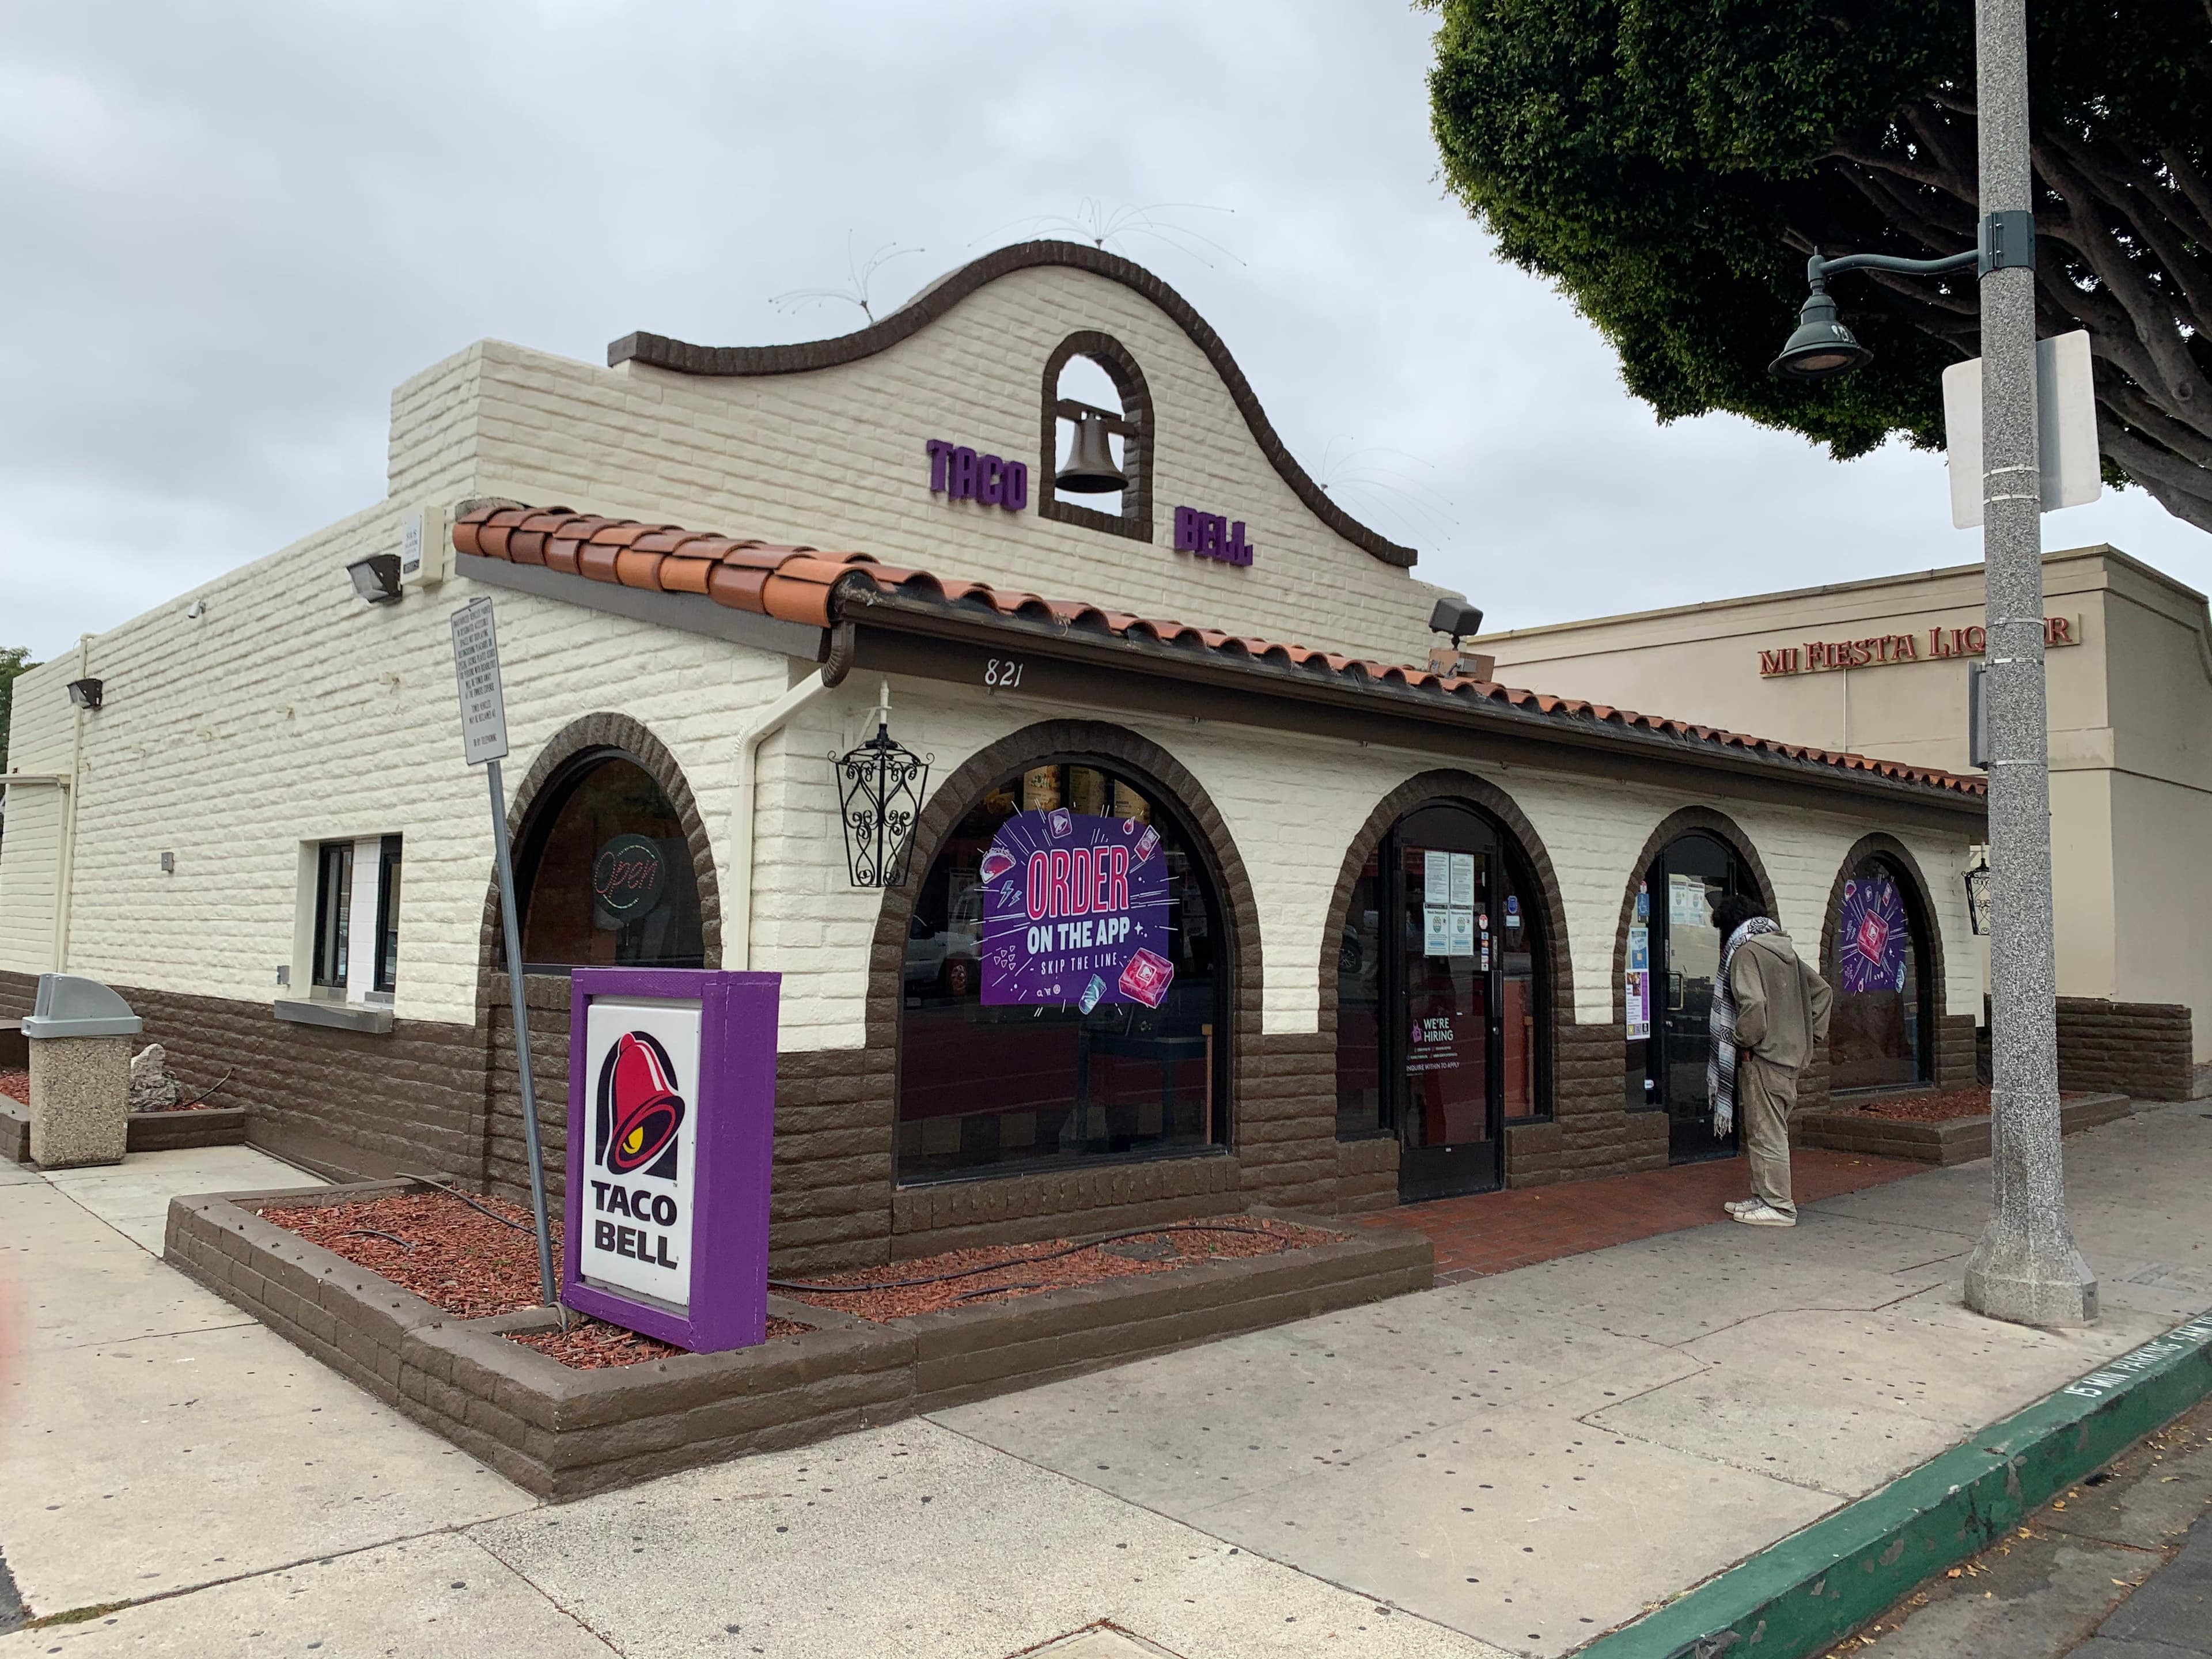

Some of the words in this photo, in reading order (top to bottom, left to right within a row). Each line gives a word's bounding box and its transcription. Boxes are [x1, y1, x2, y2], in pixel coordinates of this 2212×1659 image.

[927, 439, 1027, 511] TACO
[1175, 506, 1253, 567] BELL
[1758, 648, 1798, 675] MI
[1804, 634, 1917, 671] FIESTA
[1929, 617, 2073, 657] LIQR
[984, 658, 1023, 687] 821
[594, 851, 658, 898] Open
[1027, 845, 1129, 921] ORDER
[1027, 925, 1053, 955] ON
[1058, 921, 1093, 950] THE
[1096, 916, 1130, 946] APP
[1041, 959, 1065, 975] SKIP
[1070, 956, 1088, 972] THE
[1094, 952, 1117, 968] LINE
[1423, 1017, 1449, 1030] WE'RE
[1424, 1030, 1453, 1043] HIRING
[590, 1179, 677, 1227] TACO
[594, 1219, 677, 1270] BELL
[2109, 1342, 2183, 1373] PARKING
[2063, 1385, 2103, 1398] 15
[2081, 1371, 2131, 1389] MIN
